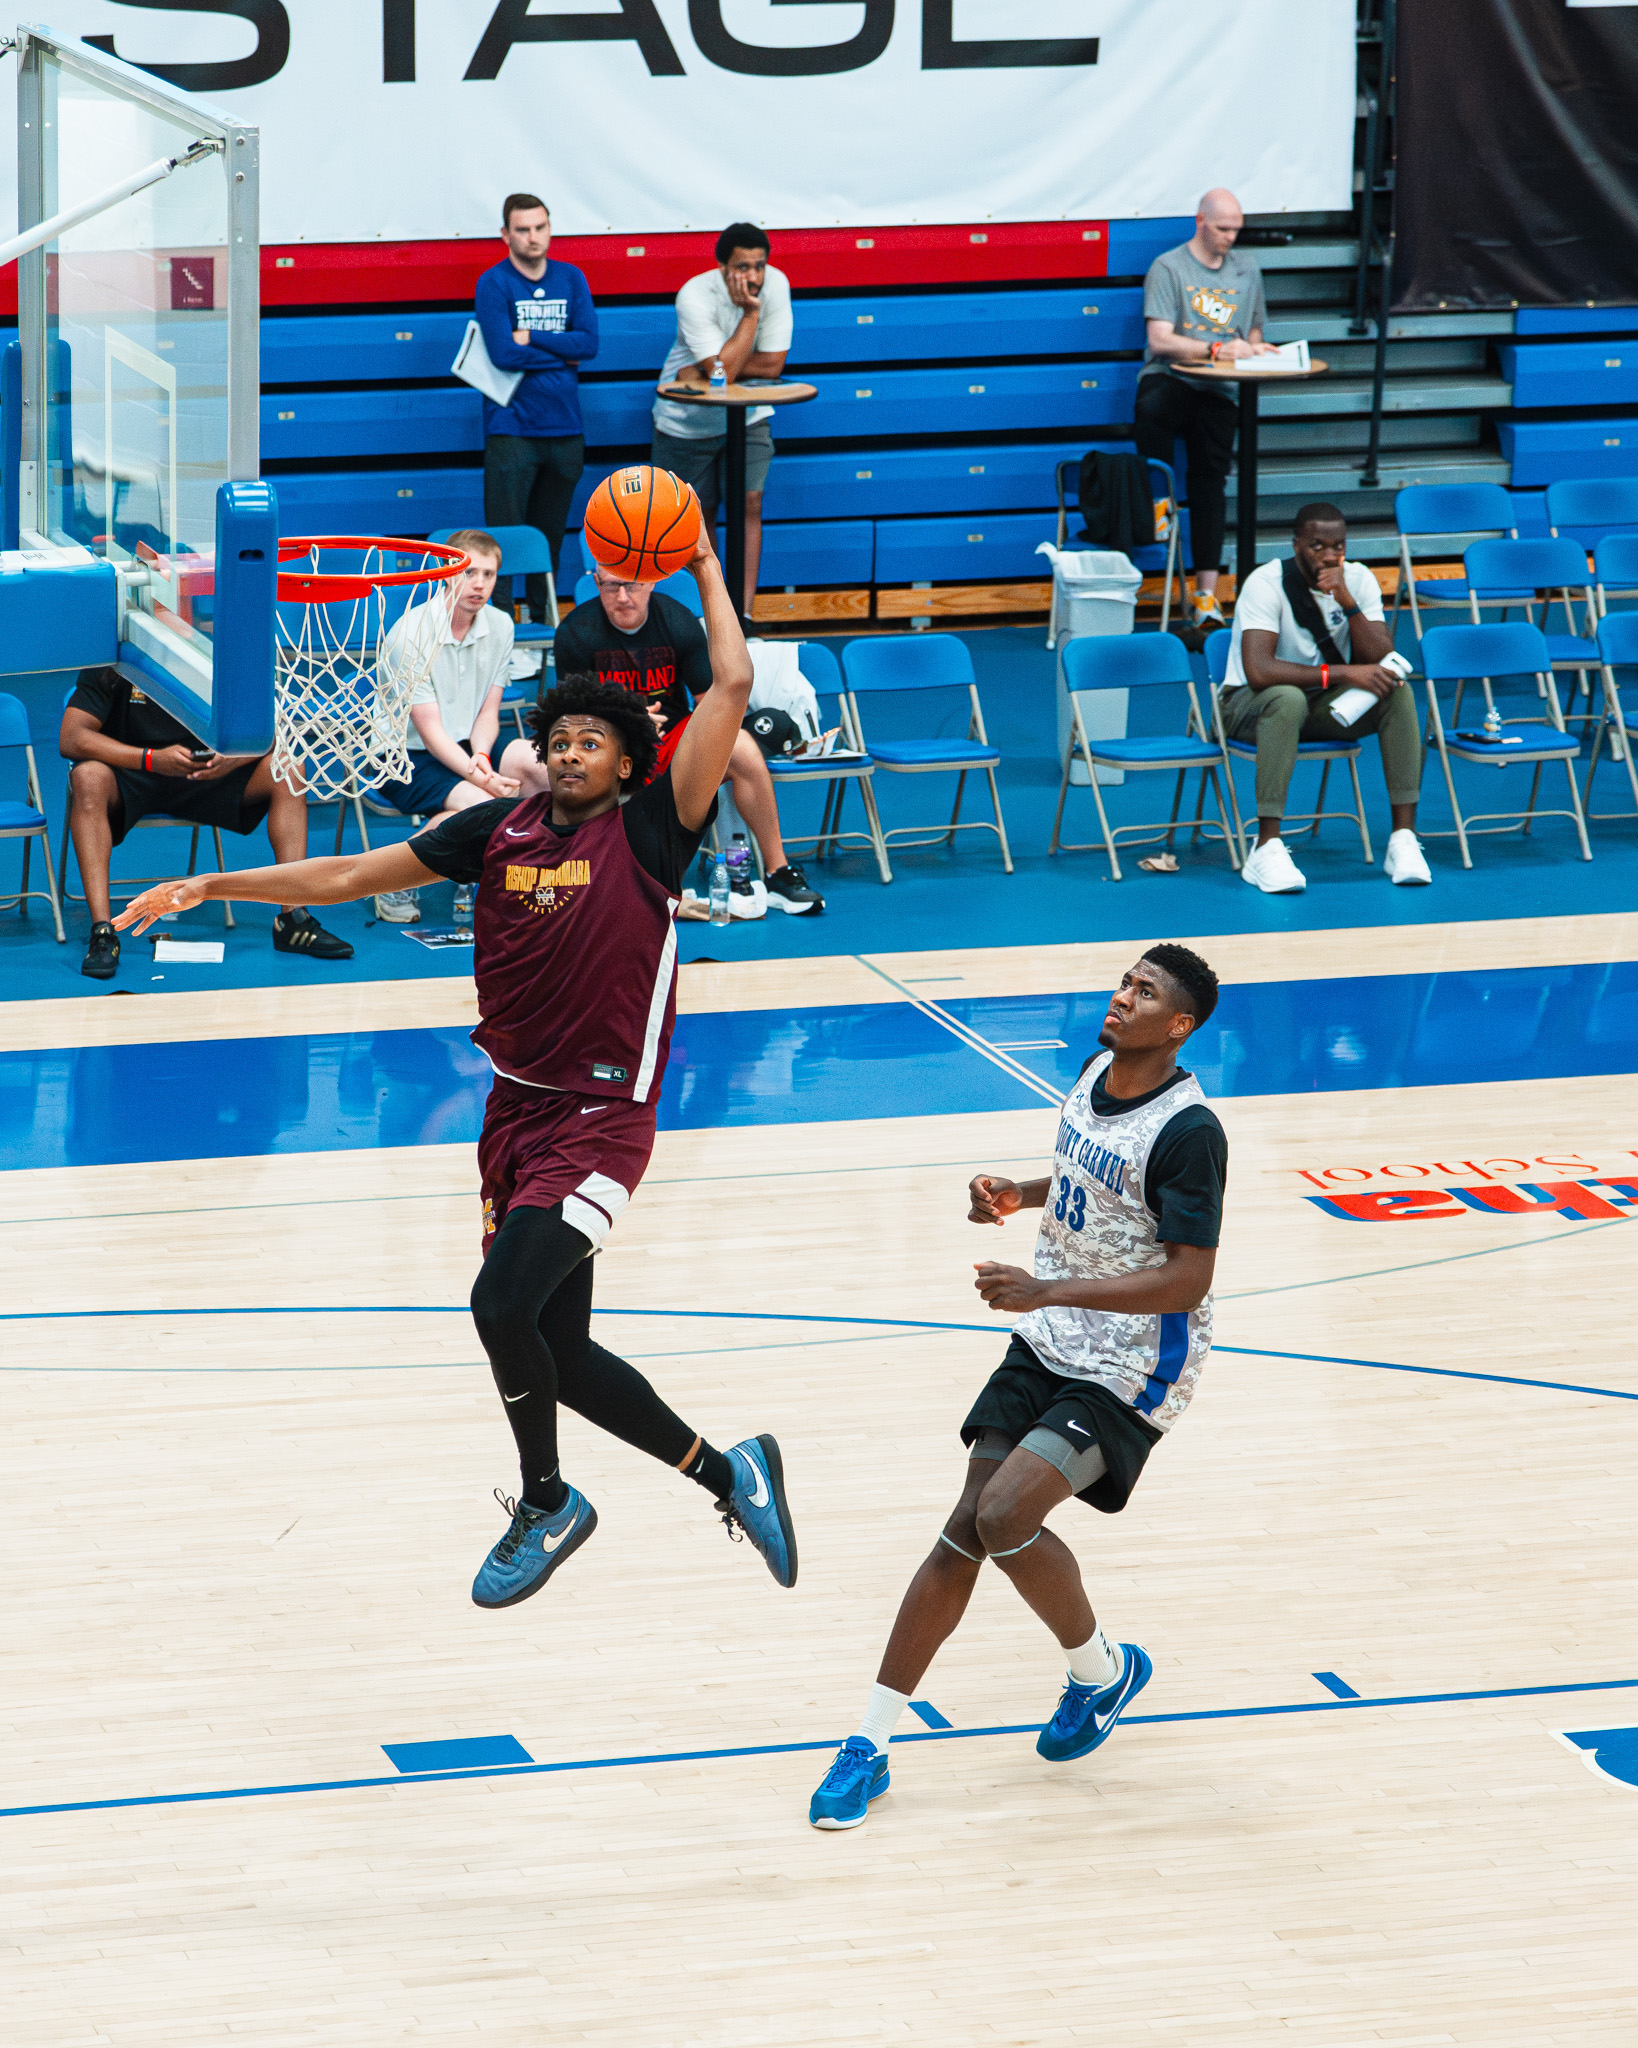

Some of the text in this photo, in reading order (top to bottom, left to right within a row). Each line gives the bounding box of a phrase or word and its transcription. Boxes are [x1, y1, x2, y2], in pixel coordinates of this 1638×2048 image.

[1200, 294, 1233, 325] VCU
[506, 865, 538, 892] BISHOP
[613, 1070, 622, 1078] XL
[1078, 1138, 1128, 1196] CARMEL
[1295, 1153, 1599, 1190] School
[1055, 1176, 1087, 1232] 33
